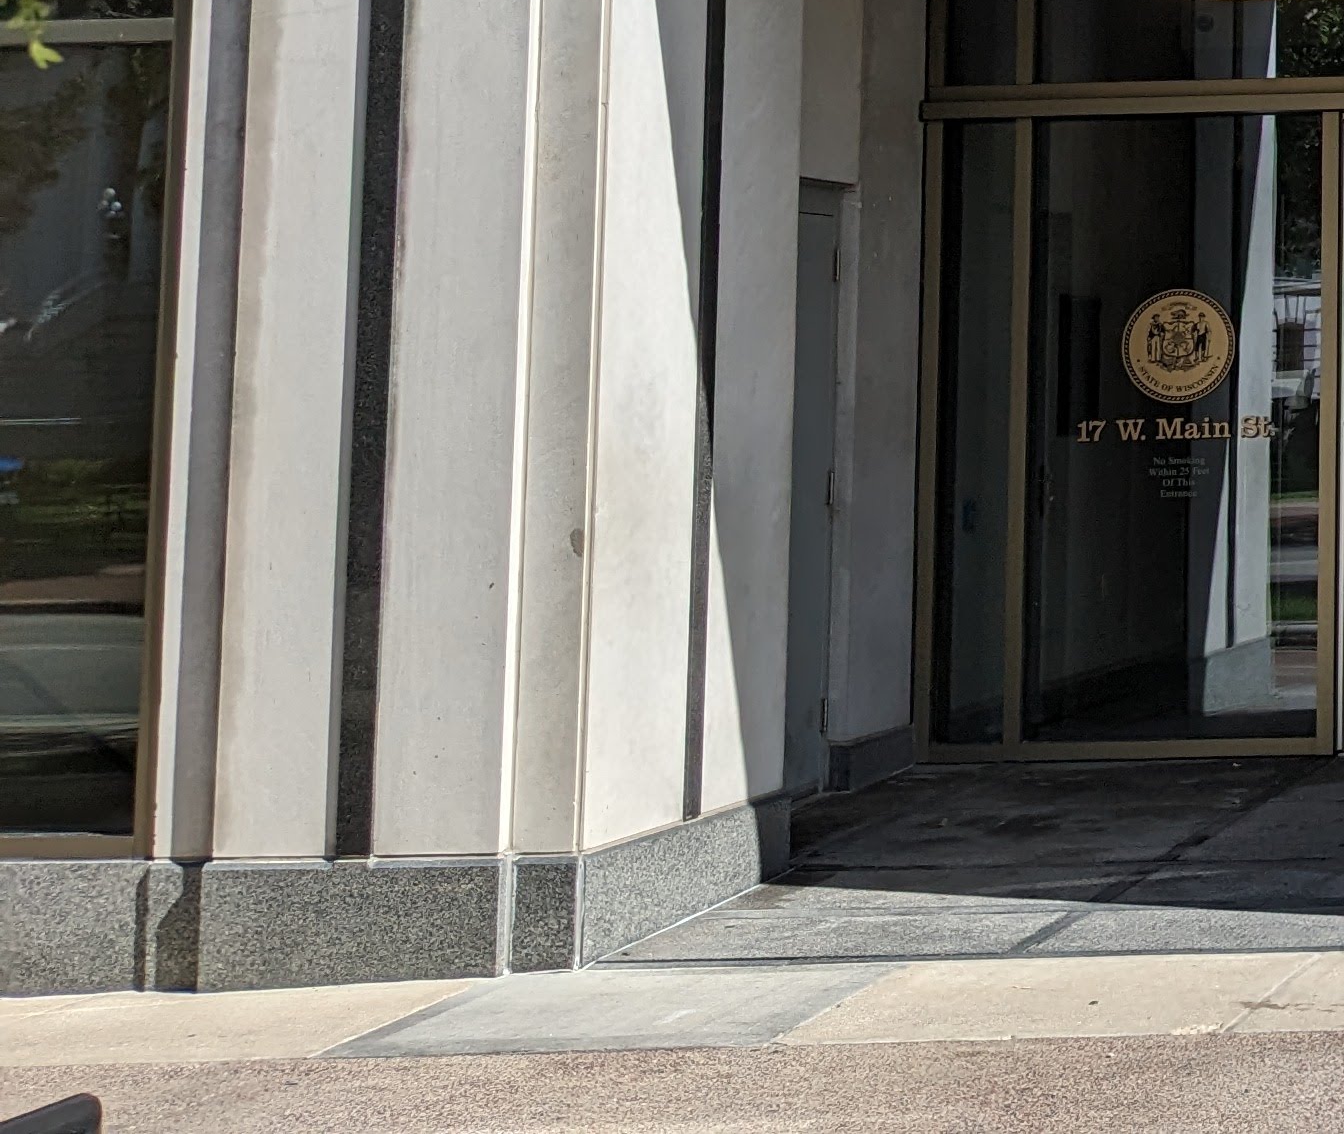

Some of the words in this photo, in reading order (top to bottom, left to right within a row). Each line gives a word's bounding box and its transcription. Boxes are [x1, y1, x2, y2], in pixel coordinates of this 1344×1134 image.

[1140, 365, 1160, 388] STATE
[1161, 383, 1174, 392] OF
[1175, 364, 1219, 393] WISCONSIN
[1076, 419, 1107, 444] 17
[1115, 418, 1146, 442] W.
[1155, 416, 1232, 441] Main
[1240, 414, 1276, 439] St.
